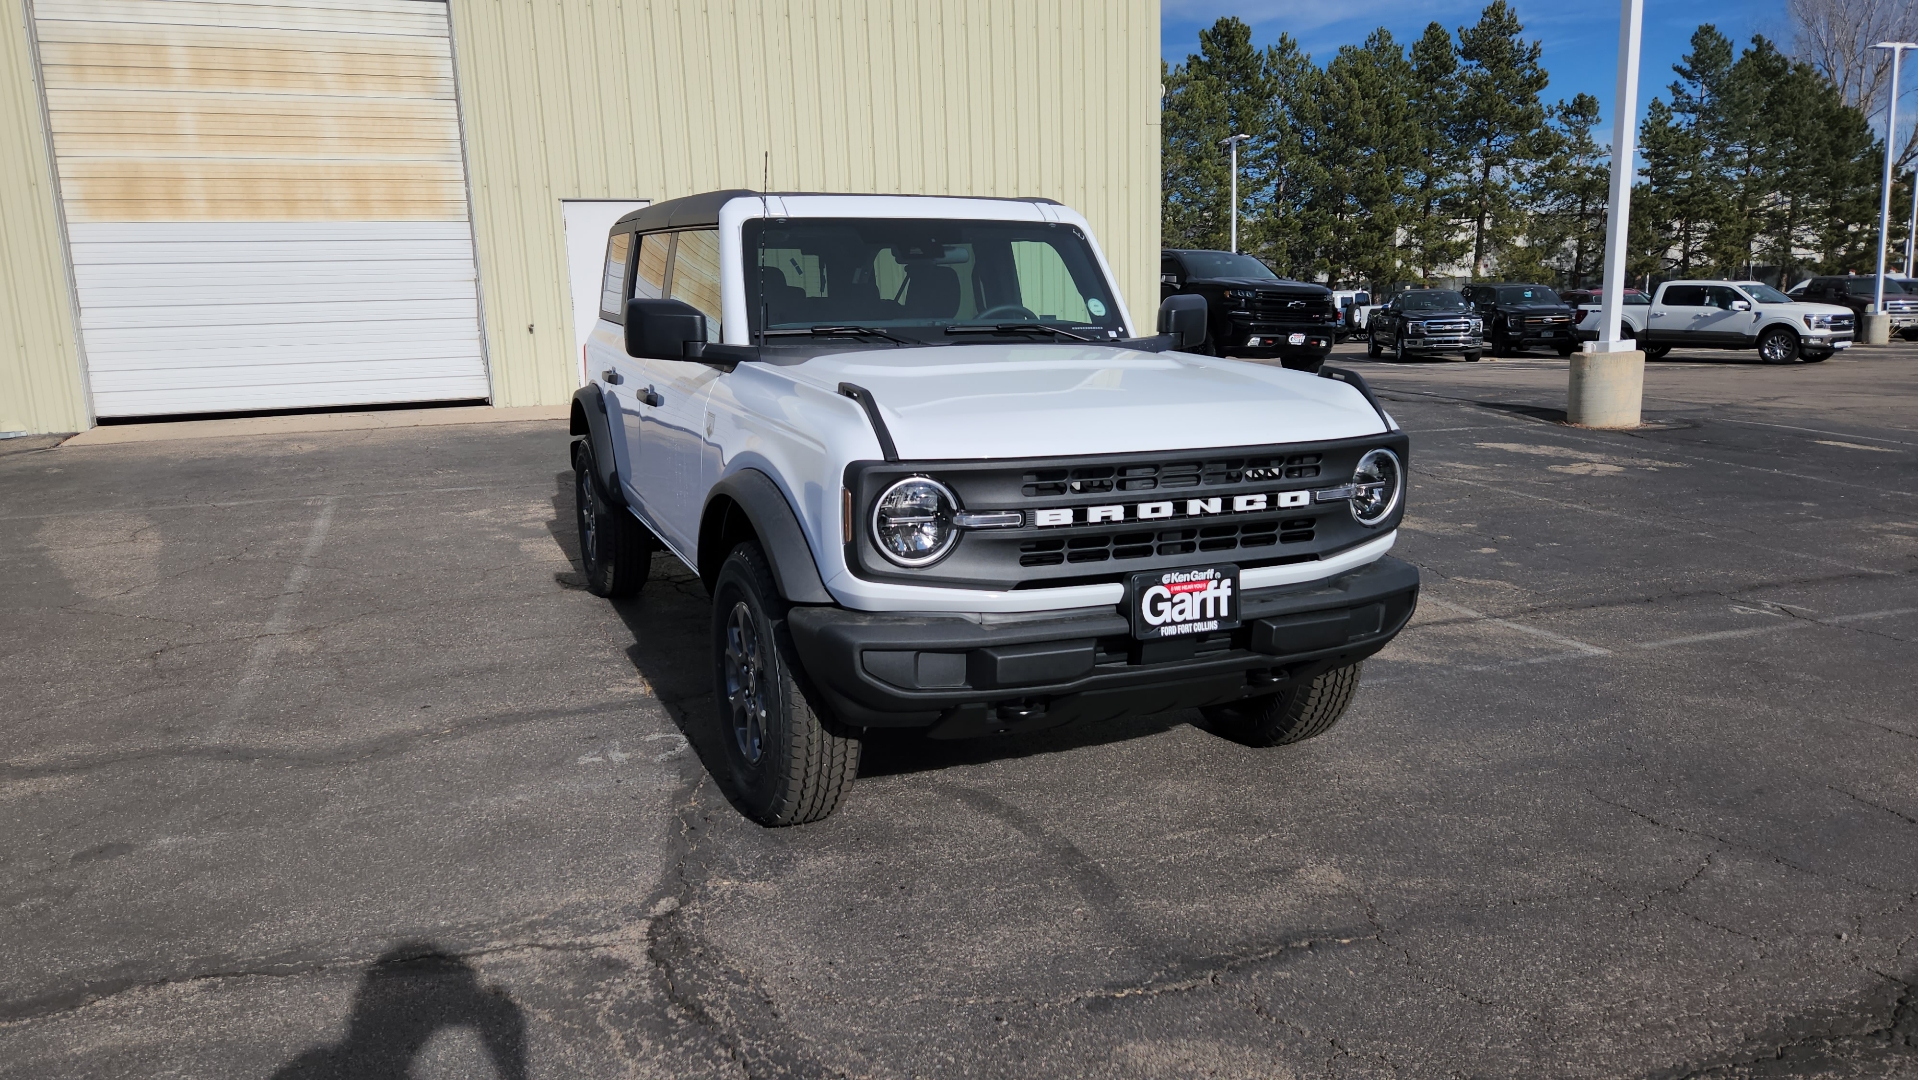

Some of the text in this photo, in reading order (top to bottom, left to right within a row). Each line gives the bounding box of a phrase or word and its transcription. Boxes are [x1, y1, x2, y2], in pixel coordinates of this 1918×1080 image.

[1035, 490, 1310, 526] BRONCO
[1141, 578, 1232, 626] Garff
[1160, 620, 1218, 636] FORD FORT COLLINS
